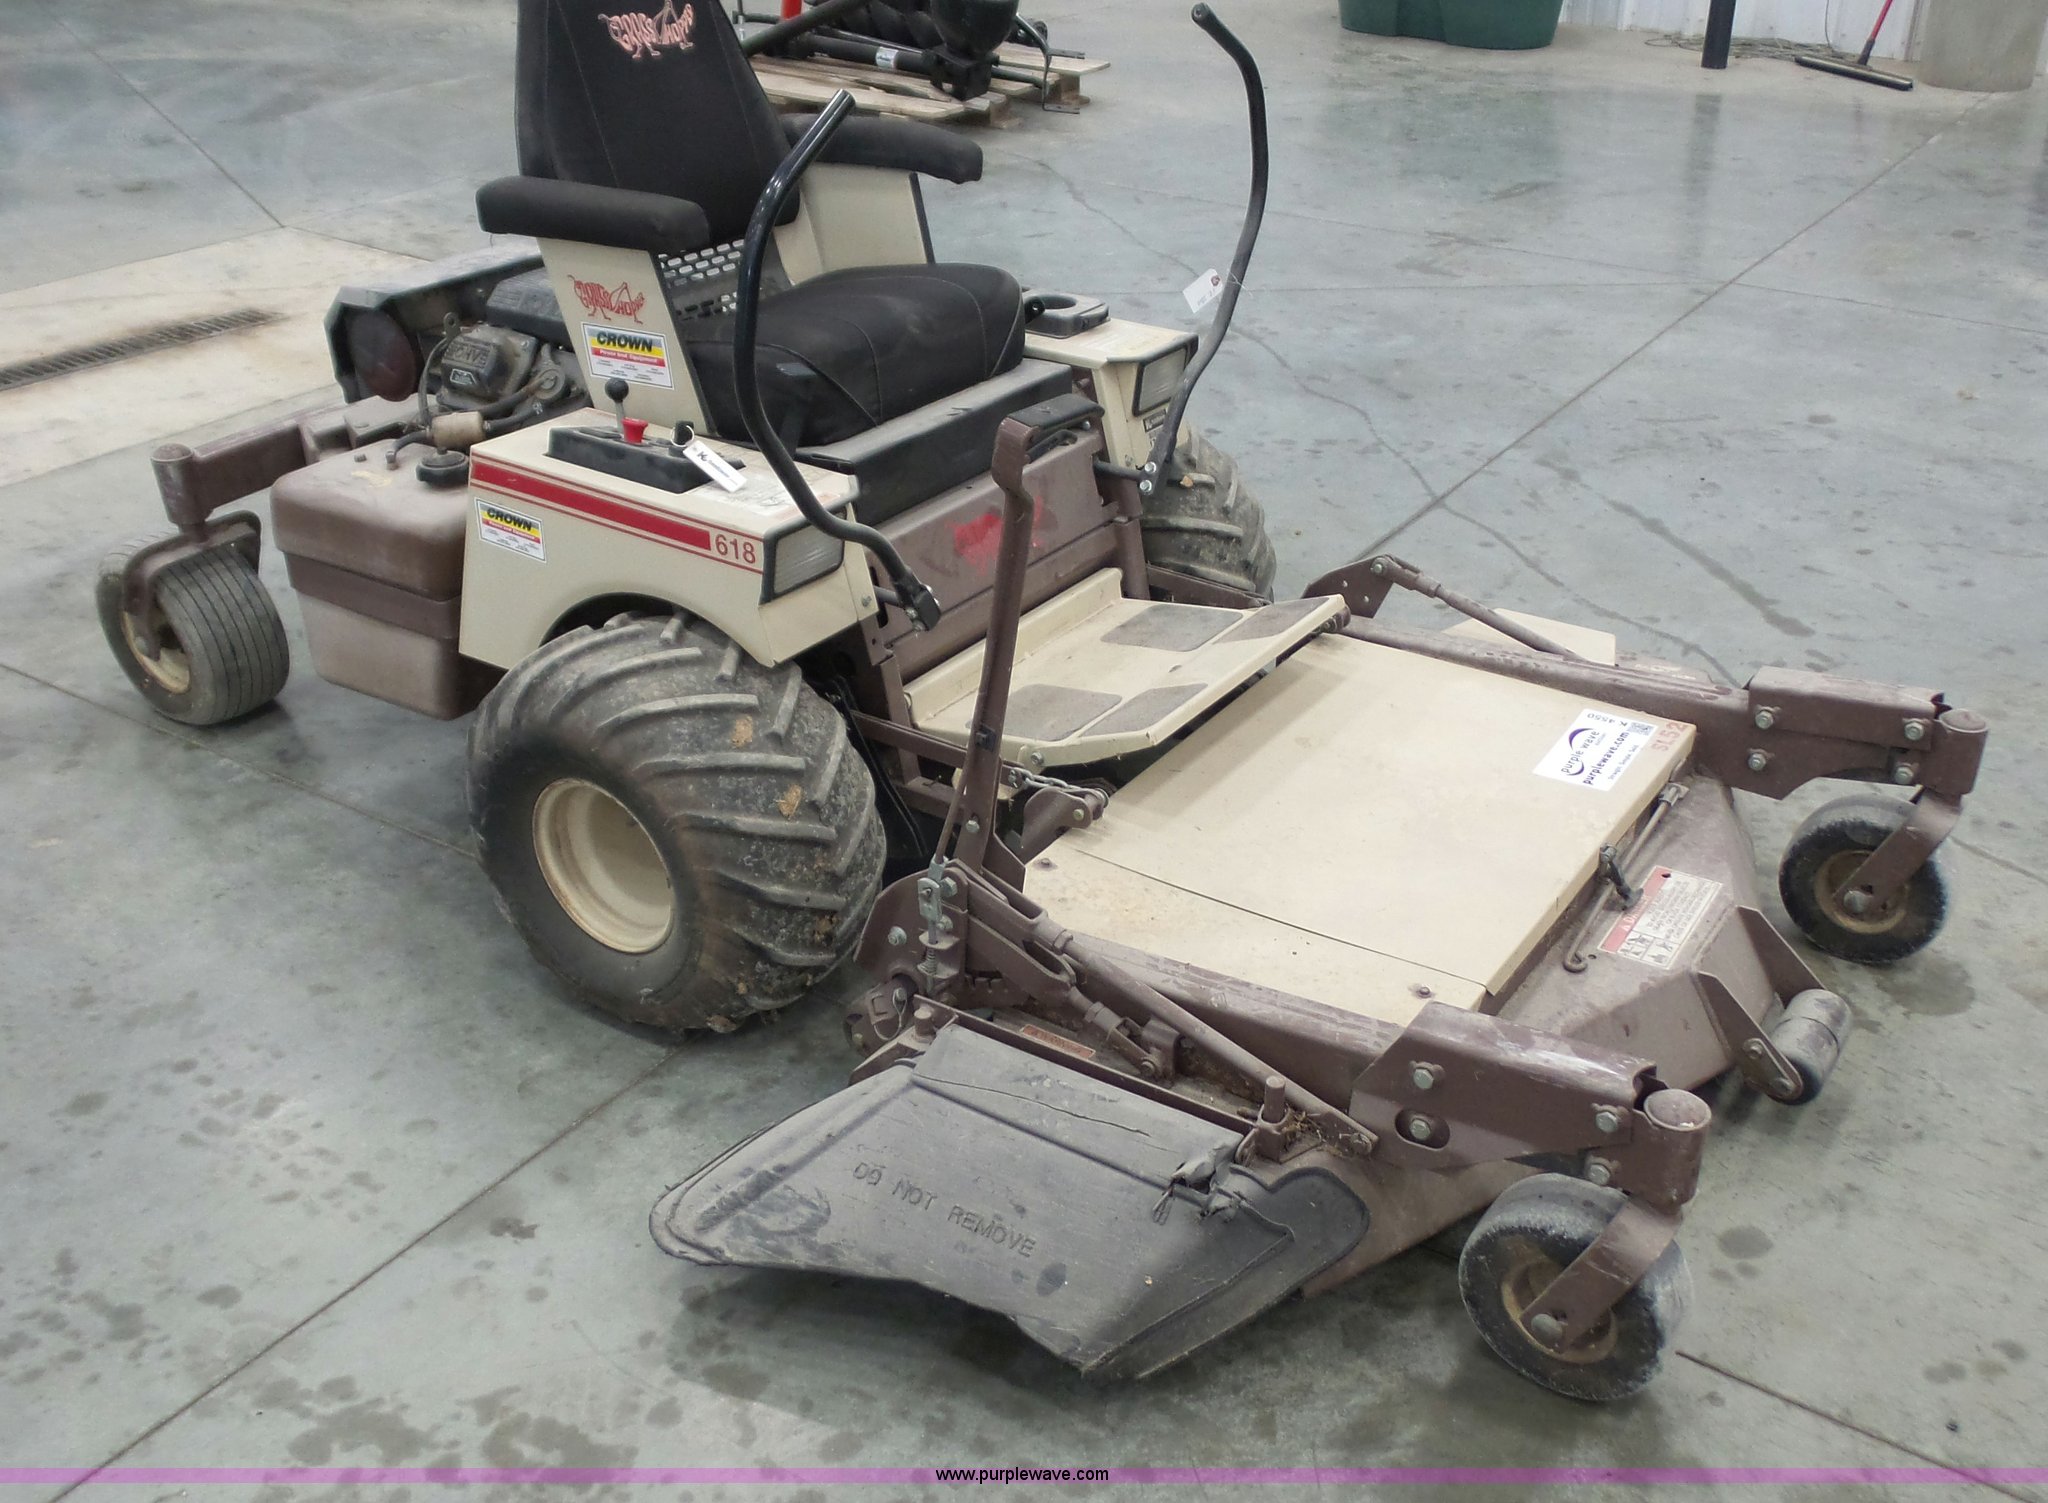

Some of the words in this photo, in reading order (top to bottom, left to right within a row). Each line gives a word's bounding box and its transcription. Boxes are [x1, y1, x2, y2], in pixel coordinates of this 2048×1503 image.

[596, 331, 654, 353] CROWN
[486, 508, 533, 531] CROWN
[715, 534, 756, 564] 618
[1561, 750, 1582, 774] purple
[1581, 730, 1601, 751] wave
[1583, 730, 1630, 786] purplewave.com
[852, 1162, 884, 1187] DO
[892, 1179, 938, 1211] NOT
[947, 1205, 1037, 1259] REMOVE
